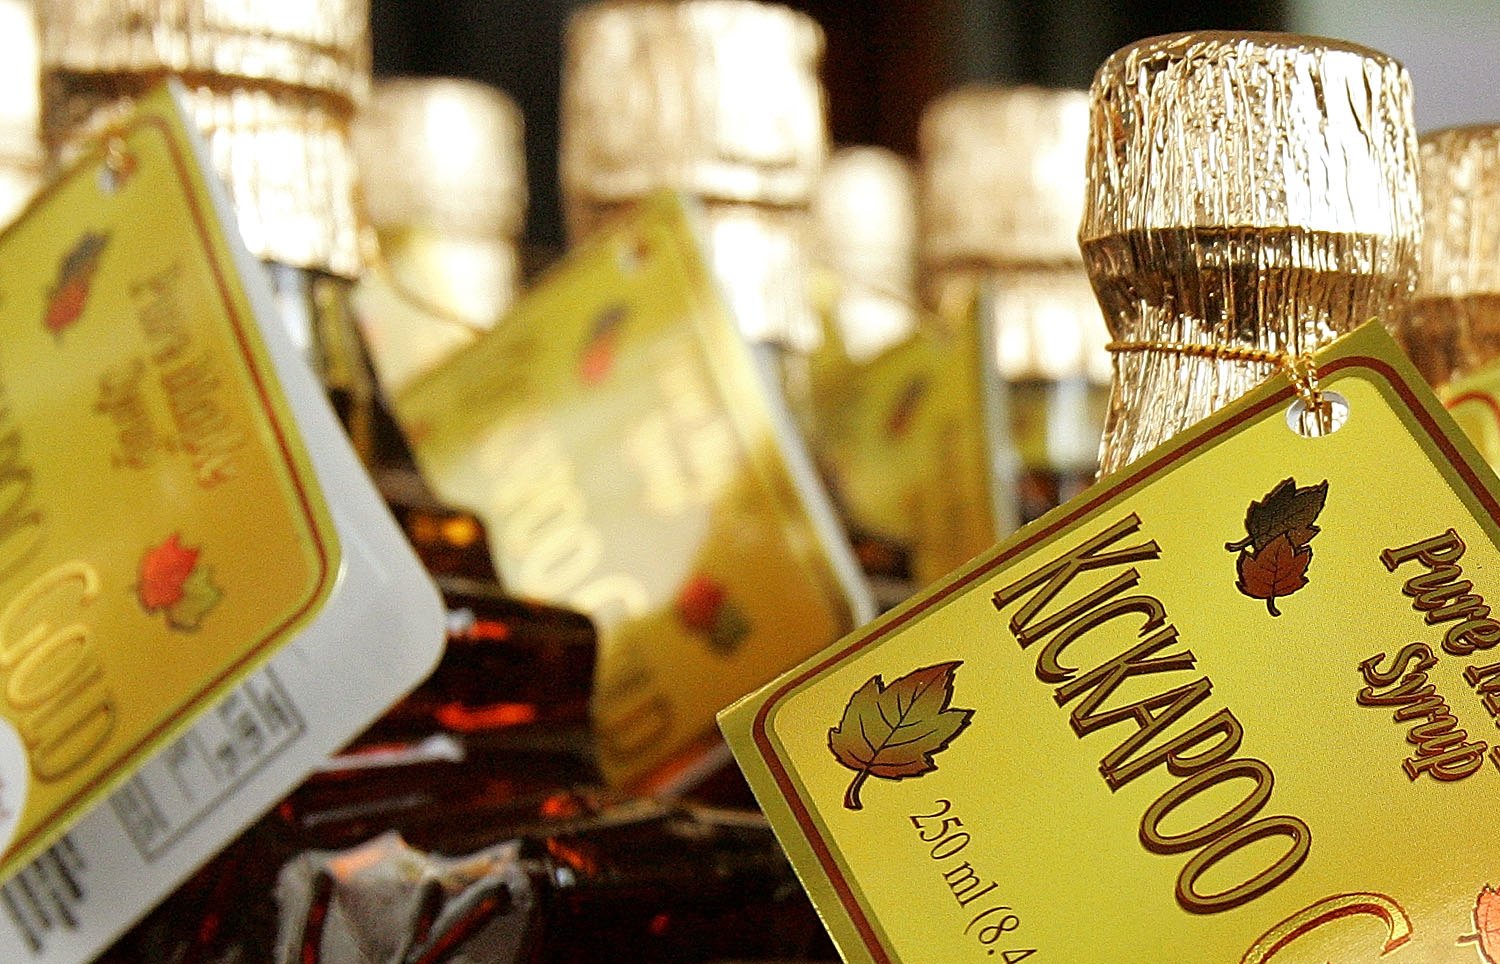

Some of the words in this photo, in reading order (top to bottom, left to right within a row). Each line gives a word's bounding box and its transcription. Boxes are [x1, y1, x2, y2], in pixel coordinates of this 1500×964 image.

[992, 512, 1312, 915] KICKAPOO
[1357, 642, 1488, 782] Syrup
[909, 799, 970, 860] 250
[942, 861, 998, 908] ml
